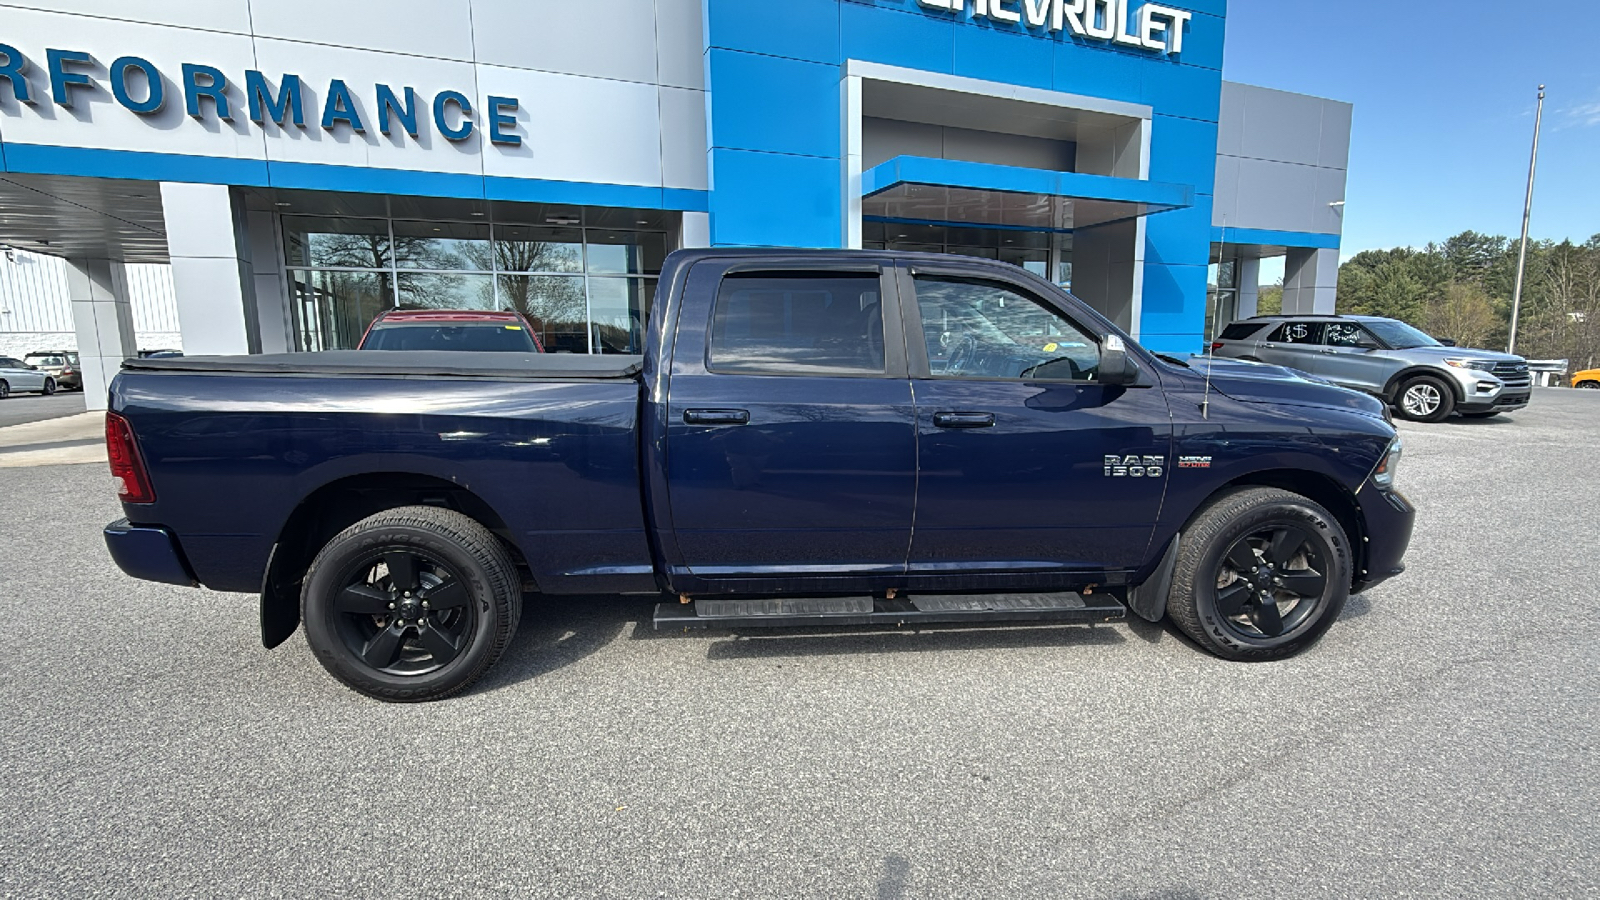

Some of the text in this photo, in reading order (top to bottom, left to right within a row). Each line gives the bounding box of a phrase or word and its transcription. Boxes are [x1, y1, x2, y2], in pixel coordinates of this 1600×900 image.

[918, 0, 1192, 54] VROLET
[1104, 454, 1164, 466] RAM
[1103, 466, 1163, 477] 1500
